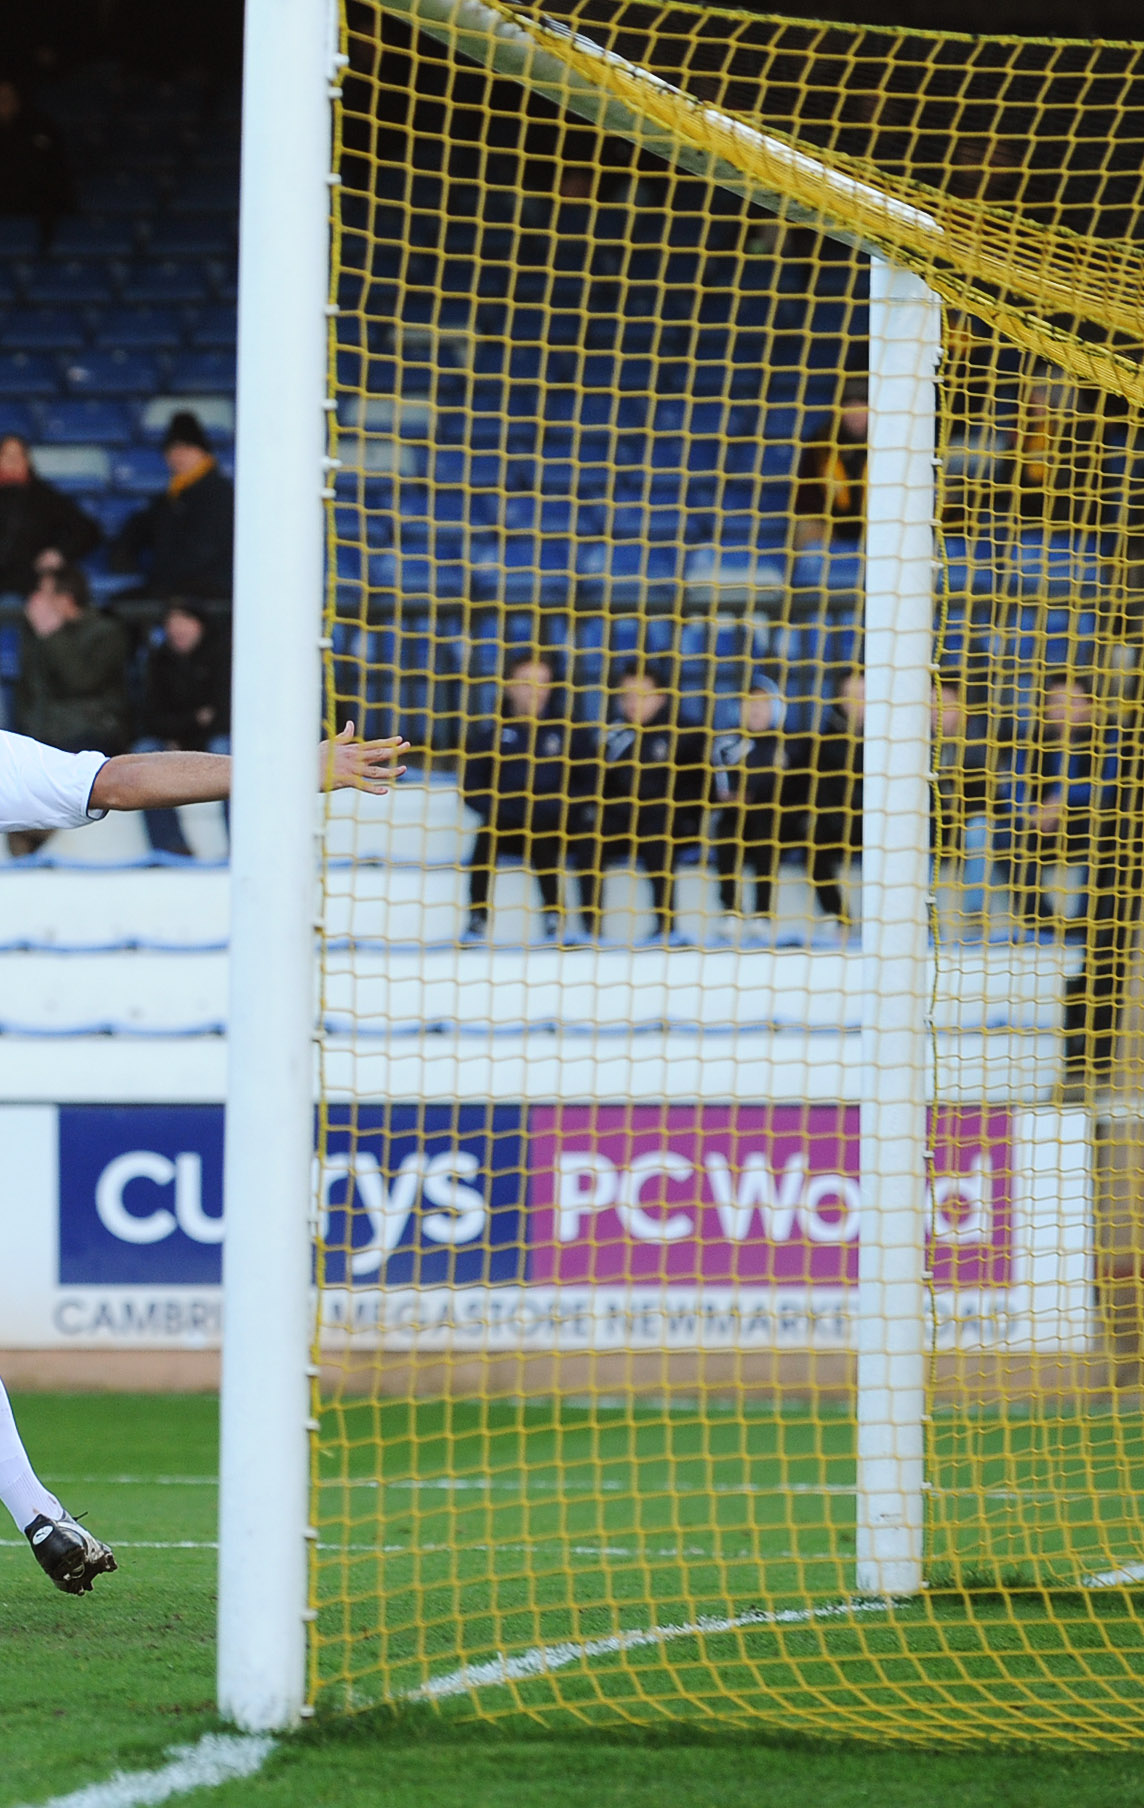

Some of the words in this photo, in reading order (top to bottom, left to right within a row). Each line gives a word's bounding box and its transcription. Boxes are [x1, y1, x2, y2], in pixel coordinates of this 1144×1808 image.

[95, 1150, 485, 1276] curys
[556, 1151, 695, 1244] PC
[704, 1151, 993, 1244] Wod
[606, 1301, 857, 1338] NEWMARKE
